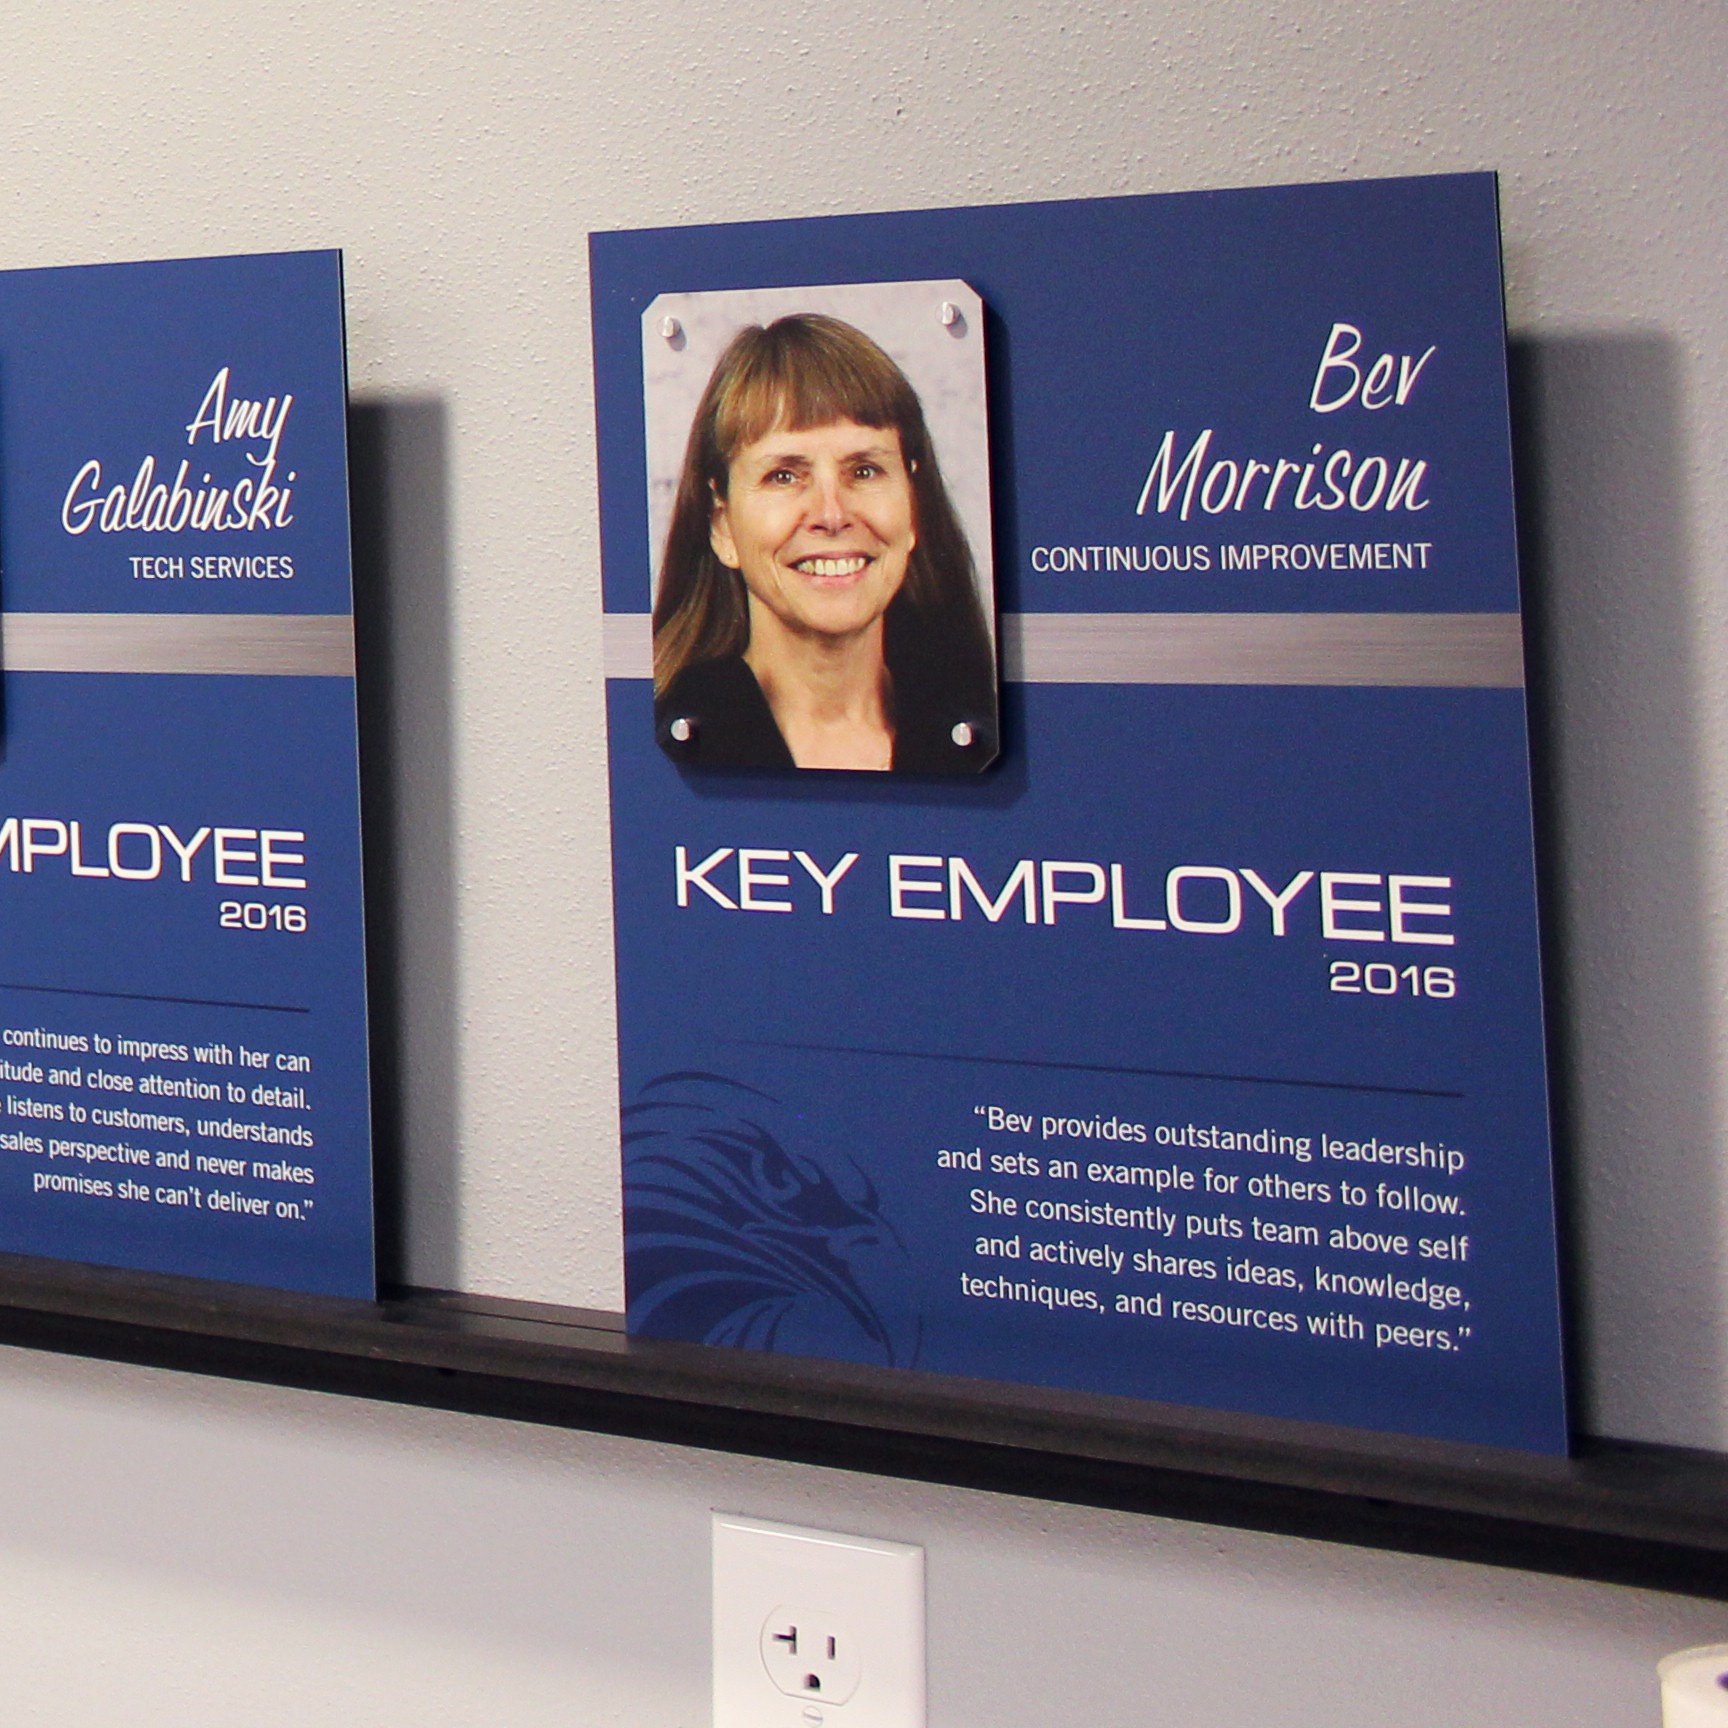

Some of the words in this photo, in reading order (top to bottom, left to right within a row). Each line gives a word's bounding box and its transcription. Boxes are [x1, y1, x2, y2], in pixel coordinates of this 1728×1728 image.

[1310, 324, 1435, 412] Bev
[186, 367, 292, 466] Amy
[61, 457, 297, 535] Galabinski
[1137, 429, 1429, 521] Morrison
[129, 557, 183, 578] TECH
[191, 556, 293, 578] SERVICES
[1032, 545, 1210, 571] CONTINUOUS
[1221, 543, 1432, 569] IMPROVEMENT
[221, 902, 306, 931] 2016
[676, 847, 859, 914] KEY
[890, 855, 1455, 945] EMPLOYEE
[1330, 962, 1455, 998] 2016
[3, 1028, 88, 1051] continues
[94, 1034, 111, 1054] to
[118, 1035, 188, 1062] impress
[194, 1044, 232, 1065] with
[240, 1046, 270, 1068] her
[276, 1054, 310, 1072] can
[49, 1067, 81, 1086] and
[87, 1069, 133, 1092] close
[139, 1075, 220, 1100] attention
[227, 1083, 245, 1103] to
[252, 1085, 311, 1110] detail.
[8, 1095, 63, 1120] listens
[69, 1103, 86, 1122] to
[92, 1108, 190, 1136] customers,
[198, 1118, 313, 1147] understands
[1043, 1115, 1146, 1142] provides
[1155, 1124, 1312, 1162] outstanding
[1322, 1134, 1464, 1175] leadership
[0, 1132, 43, 1153] sales
[49, 1140, 150, 1165] perspective
[156, 1150, 189, 1170] and
[197, 1156, 247, 1176] never
[253, 1160, 314, 1184] makes
[938, 1148, 981, 1170] and
[991, 1152, 1040, 1175] sets
[1049, 1160, 1077, 1179] an
[1088, 1164, 1194, 1192] example
[1204, 1168, 1239, 1193] for
[1248, 1174, 1331, 1202] others
[1340, 1181, 1366, 1206] to
[1376, 1183, 1465, 1215] follow.
[34, 1173, 113, 1196] promises
[118, 1179, 149, 1201] she
[208, 1190, 270, 1215] deliver
[971, 1189, 1017, 1216] She
[1026, 1200, 1176, 1236] consistently
[1187, 1214, 1243, 1238] puts
[1252, 1217, 1318, 1245] team
[1330, 1225, 1408, 1255] above
[1419, 1236, 1468, 1261] self
[976, 1235, 1020, 1258] and
[1030, 1241, 1124, 1274] actively
[1134, 1249, 1217, 1279] shares
[1227, 1257, 1303, 1292] ideas,
[1316, 1266, 1469, 1310] knowledge,
[961, 1273, 1104, 1314] techniques,
[1116, 1293, 1162, 1316] and
[1173, 1301, 1298, 1332] resources
[1307, 1312, 1363, 1339] with
